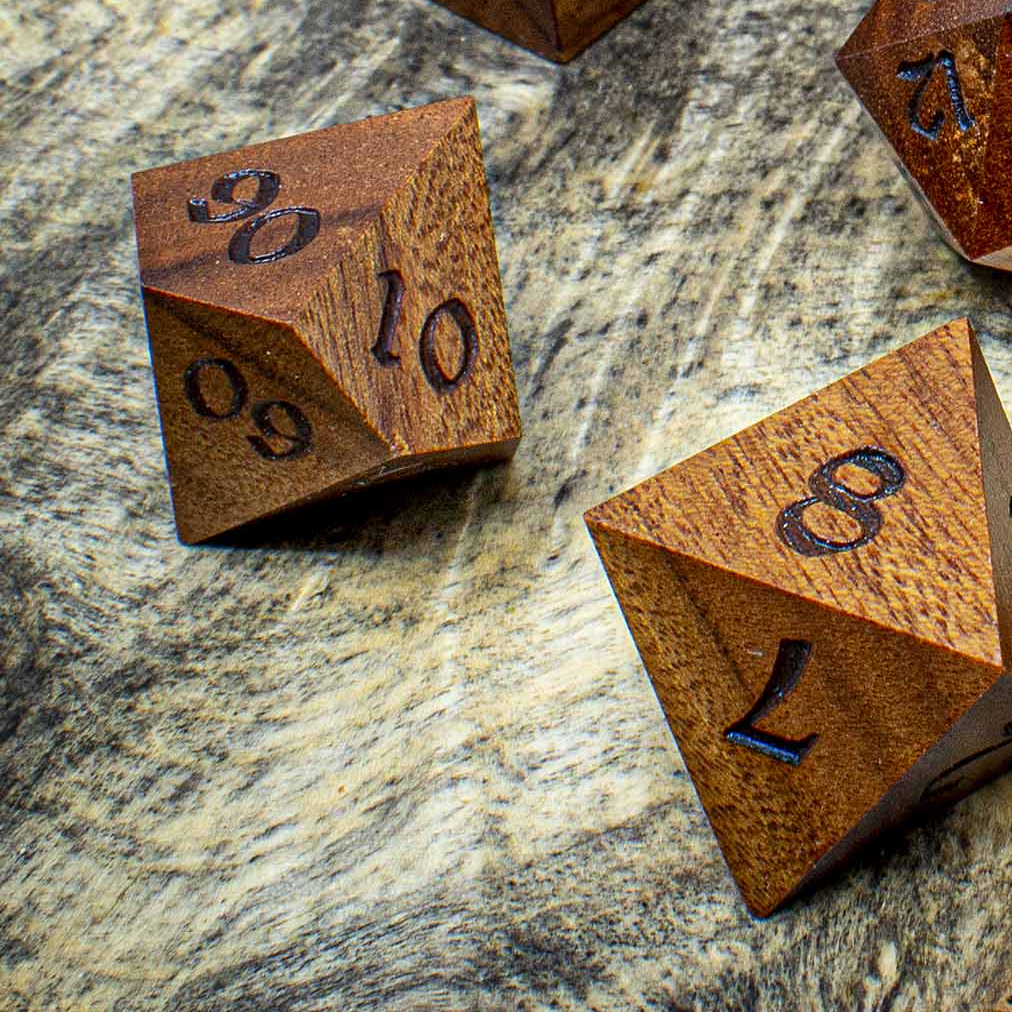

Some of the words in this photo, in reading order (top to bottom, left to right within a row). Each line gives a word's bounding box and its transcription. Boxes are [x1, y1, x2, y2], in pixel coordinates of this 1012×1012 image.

[187, 168, 321, 265] 90
[370, 268, 478, 391] 10
[775, 445, 906, 558] 8
[722, 638, 818, 766] 7
